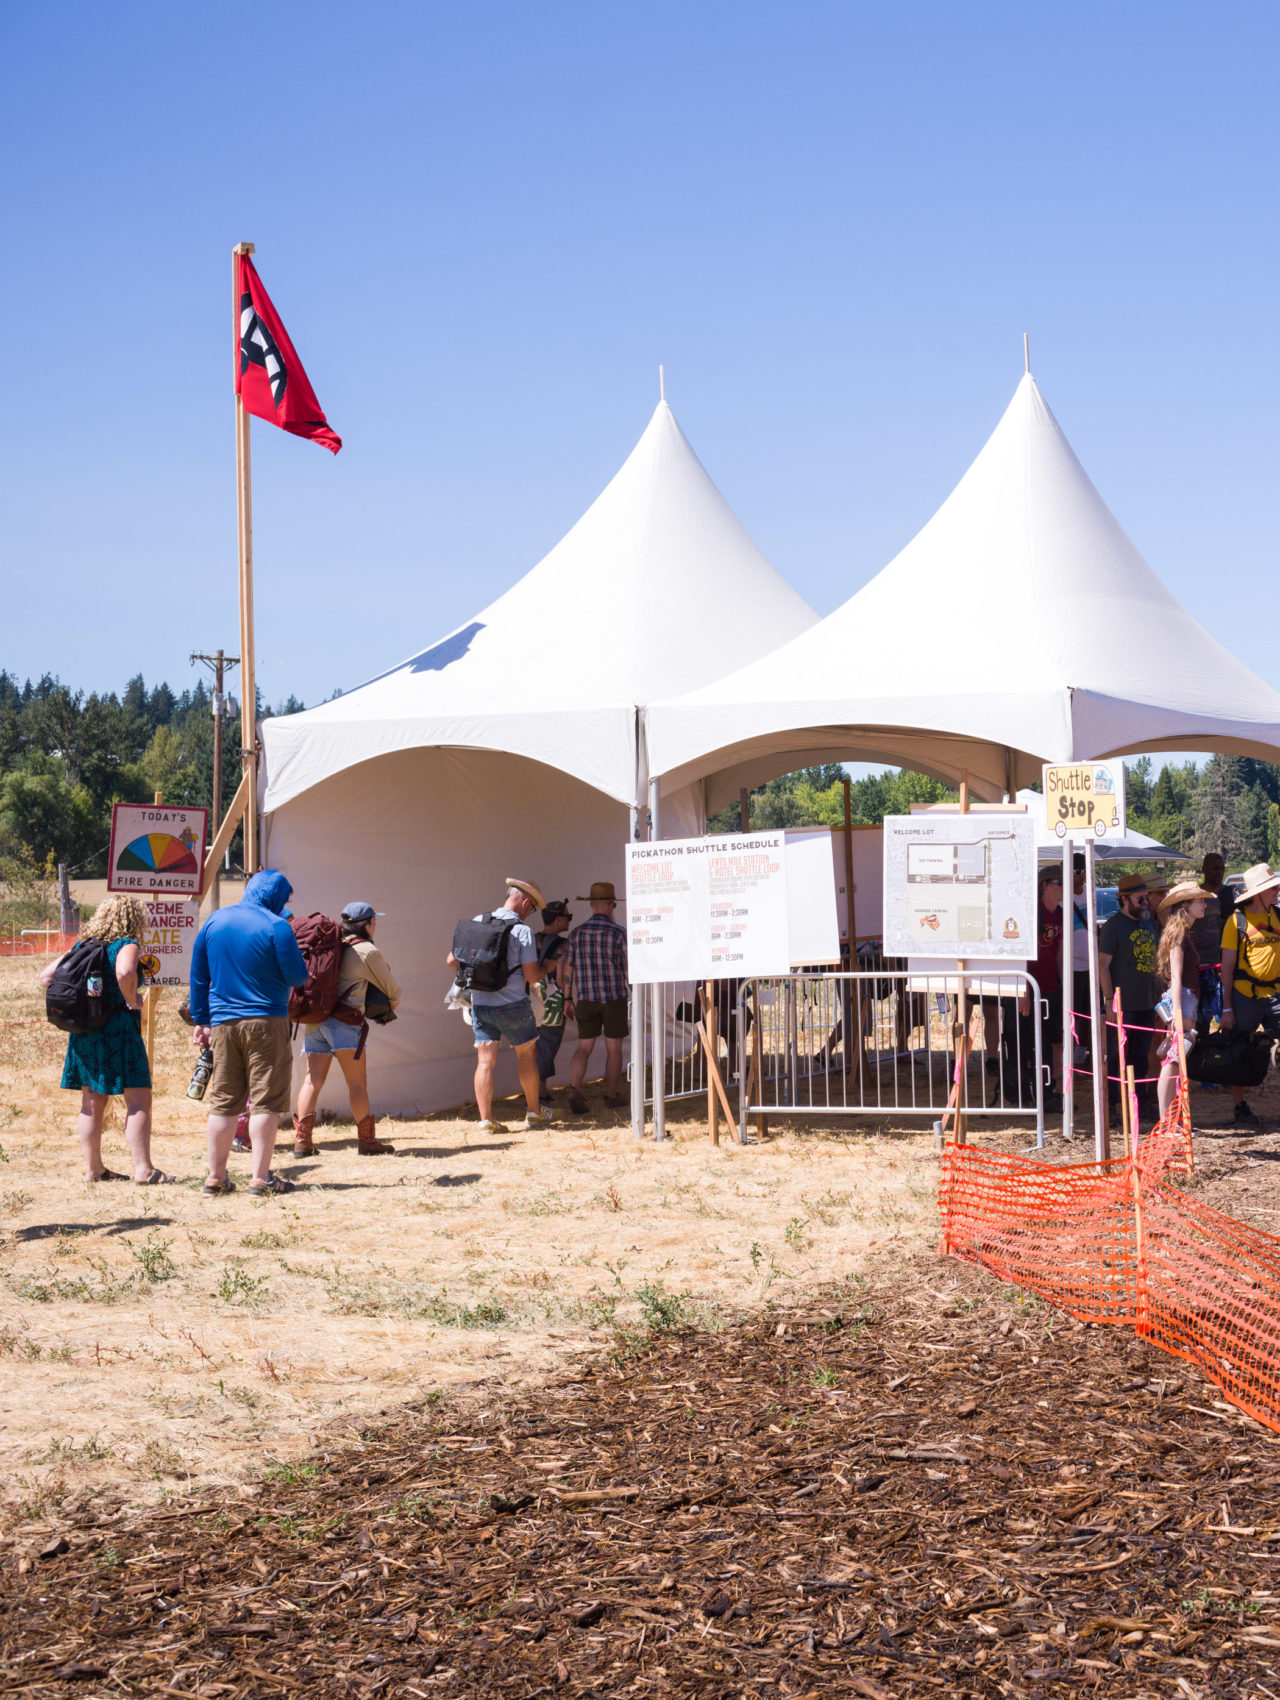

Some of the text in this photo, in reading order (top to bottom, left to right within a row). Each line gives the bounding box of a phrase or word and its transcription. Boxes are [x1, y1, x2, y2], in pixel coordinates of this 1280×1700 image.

[1049, 769, 1091, 793] Shuttle
[141, 811, 186, 822] TODAY'S
[1058, 795, 1095, 825] Stop
[632, 839, 779, 859] PICKATHON SHUTTLE SCHEDULE
[743, 854, 770, 865] STATION
[736, 864, 761, 875] SHUTTLE
[763, 862, 780, 873] LOOP
[117, 876, 195, 888] FIRE DANGER
[146, 902, 184, 915] REME
[148, 916, 194, 928] ANGER
[142, 929, 180, 945] CATE
